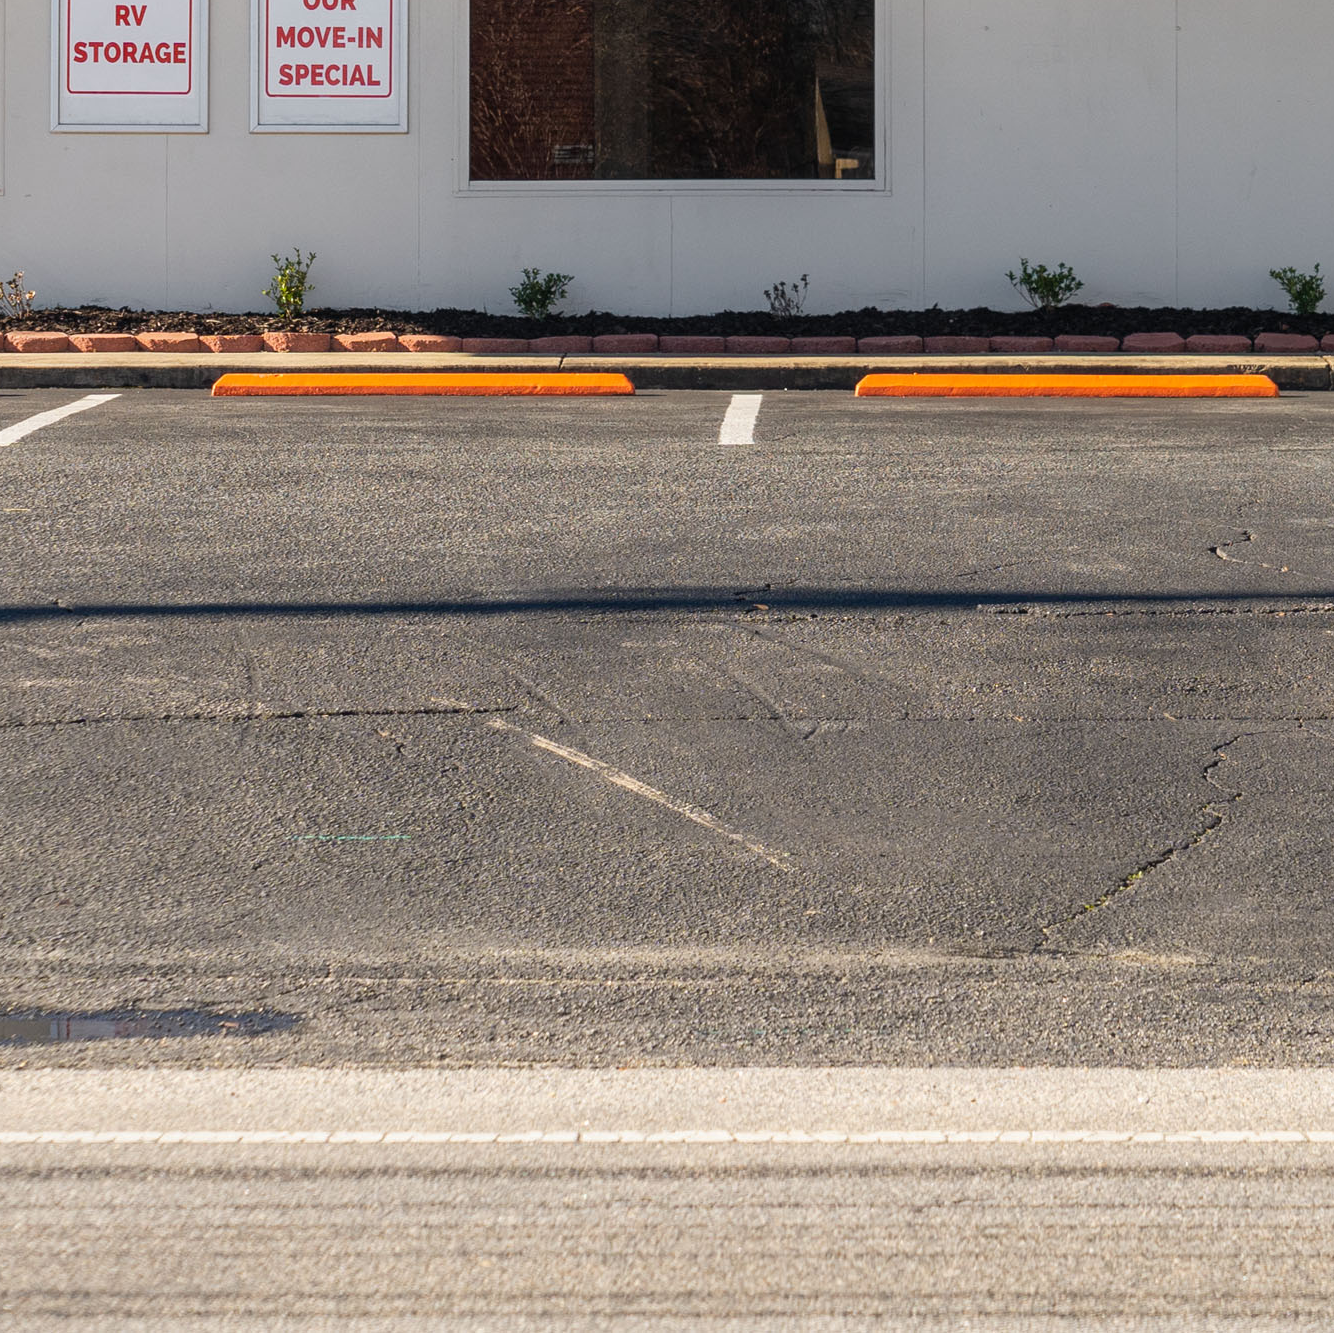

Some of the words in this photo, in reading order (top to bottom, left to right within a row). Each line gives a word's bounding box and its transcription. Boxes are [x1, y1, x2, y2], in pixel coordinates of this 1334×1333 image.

[114, 4, 148, 27] RV
[275, 26, 383, 49] MOVE-IN
[73, 41, 187, 64] STORAGE
[278, 63, 381, 87] SPECIAL
